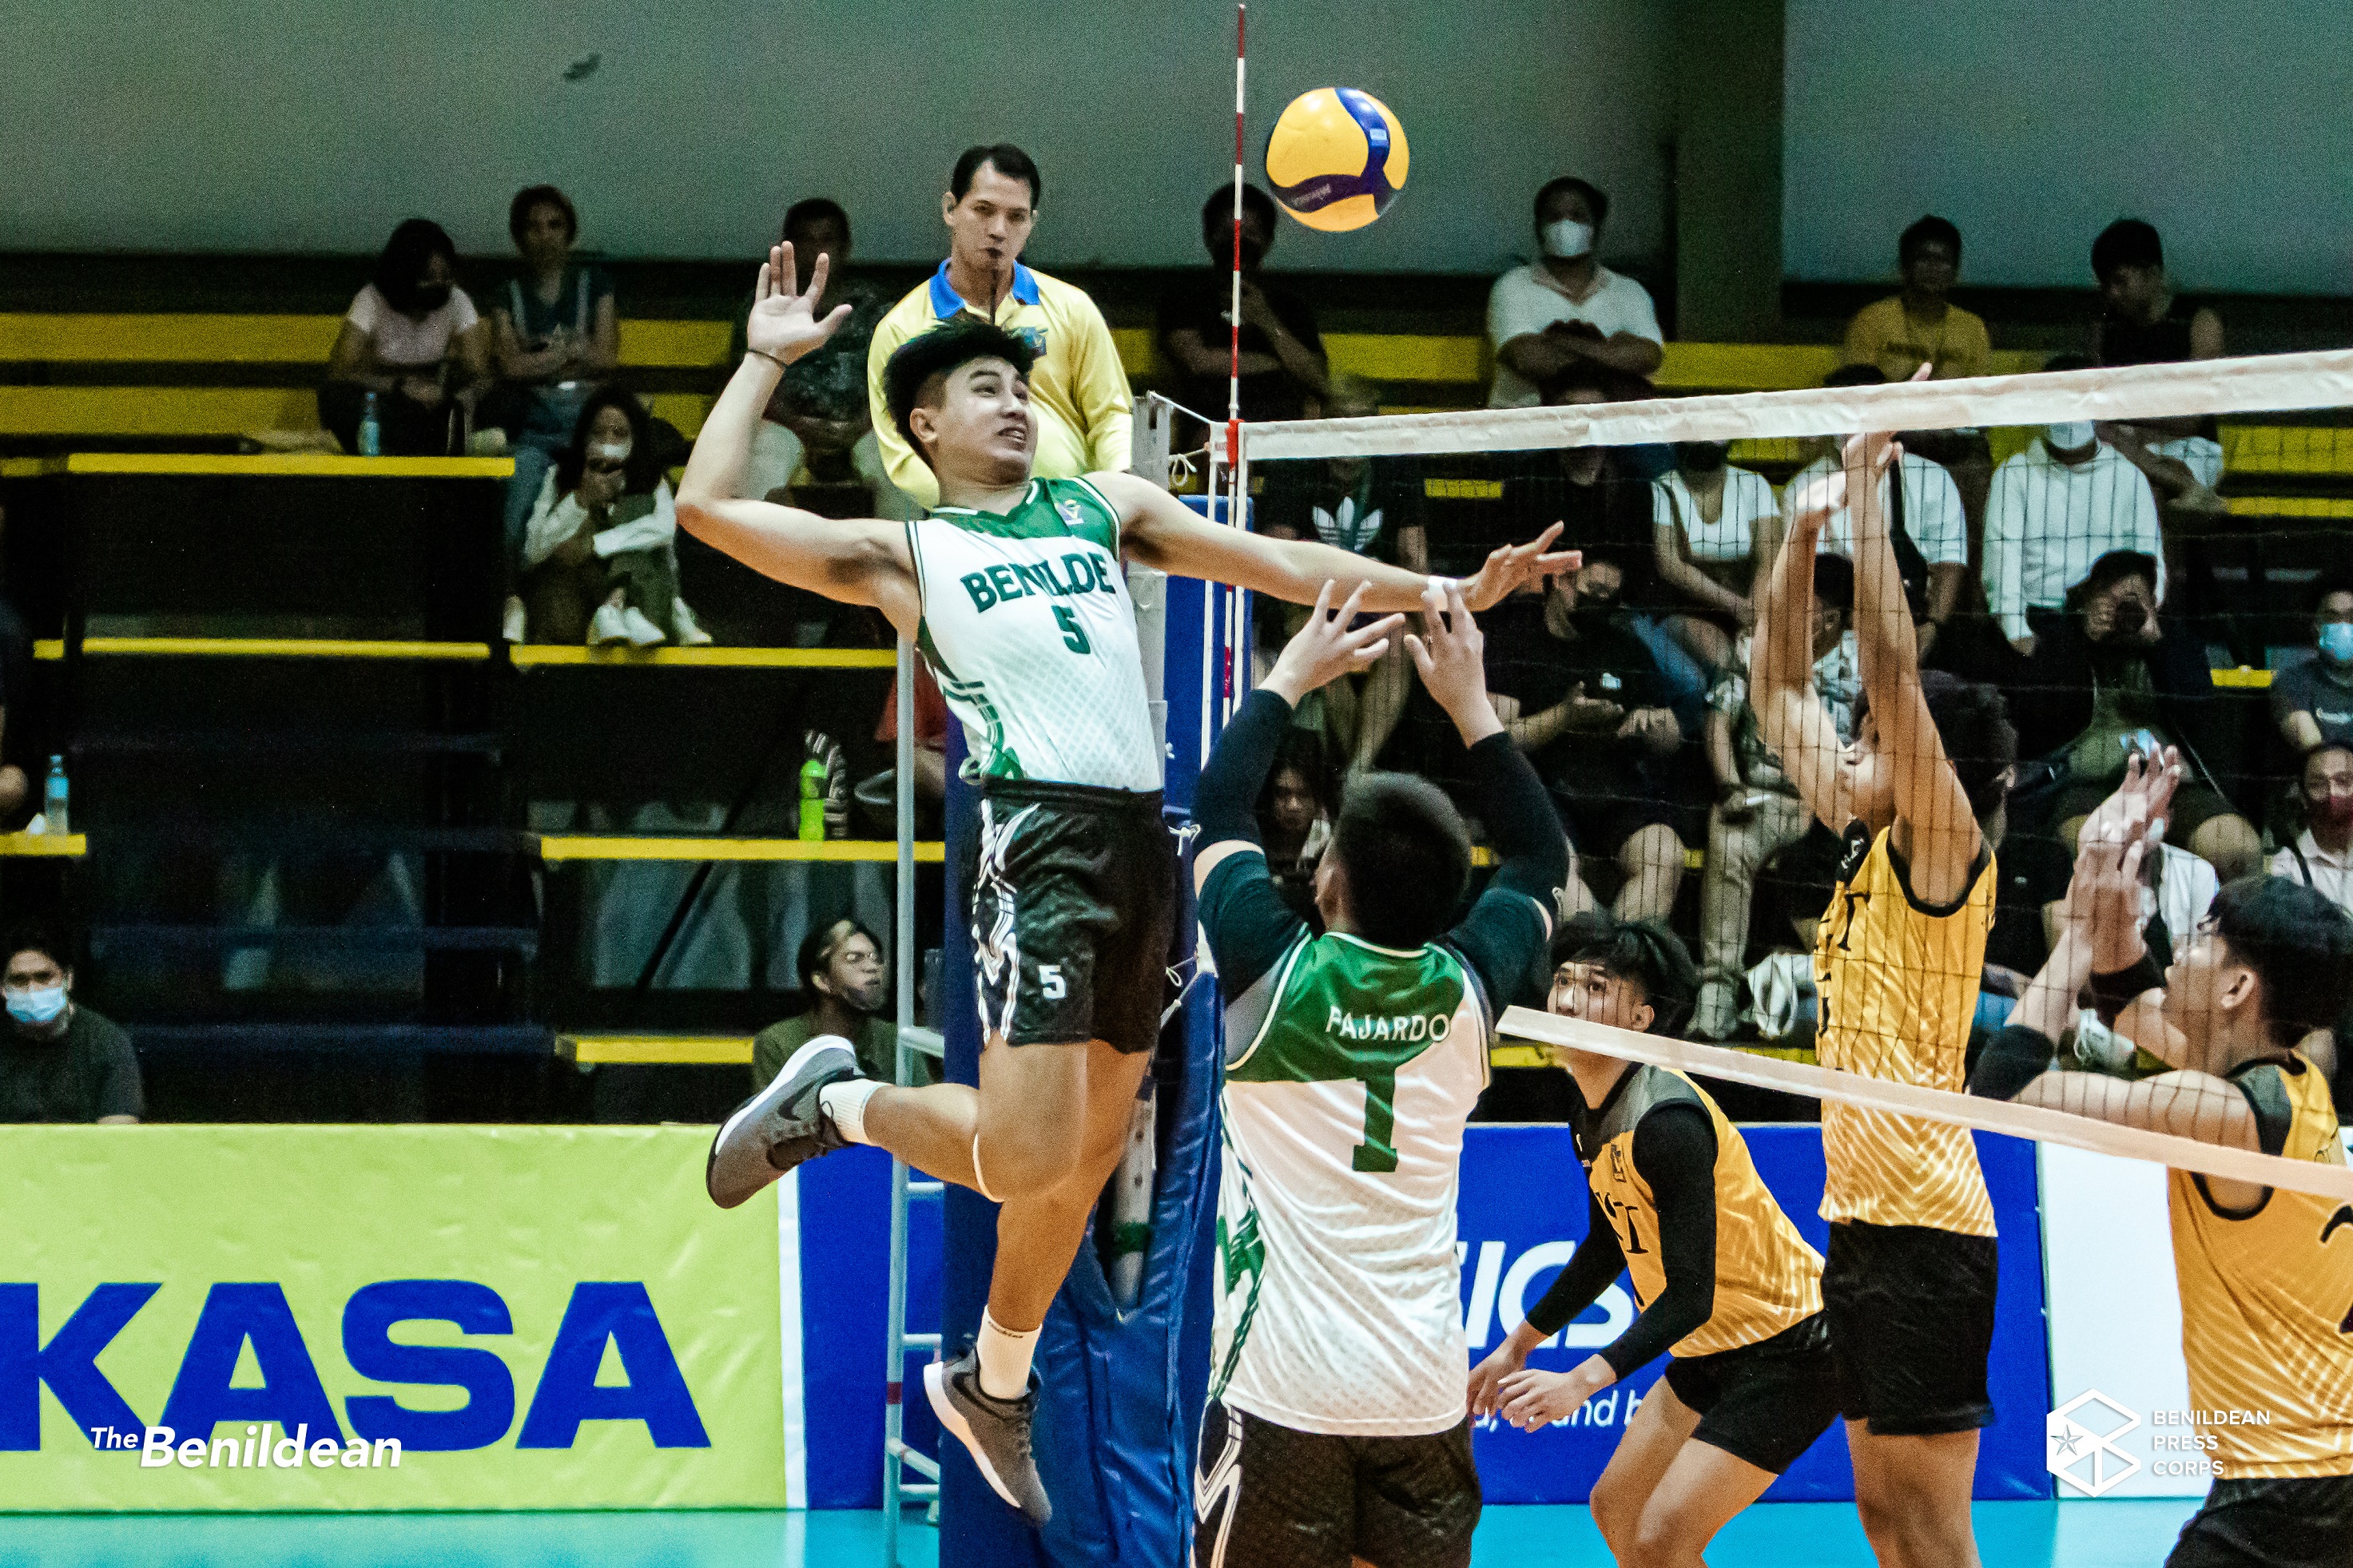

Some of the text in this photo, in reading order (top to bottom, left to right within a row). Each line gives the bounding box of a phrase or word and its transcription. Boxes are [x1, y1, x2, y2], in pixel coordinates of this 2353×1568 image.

[960, 551, 1116, 613] BENILDE
[1051, 605, 1091, 655] 5
[1039, 964, 1066, 998] 5
[1325, 1005, 1451, 1042] FAJARDO
[1351, 1064, 1398, 1173] 1
[1457, 1240, 1634, 1349] ICS
